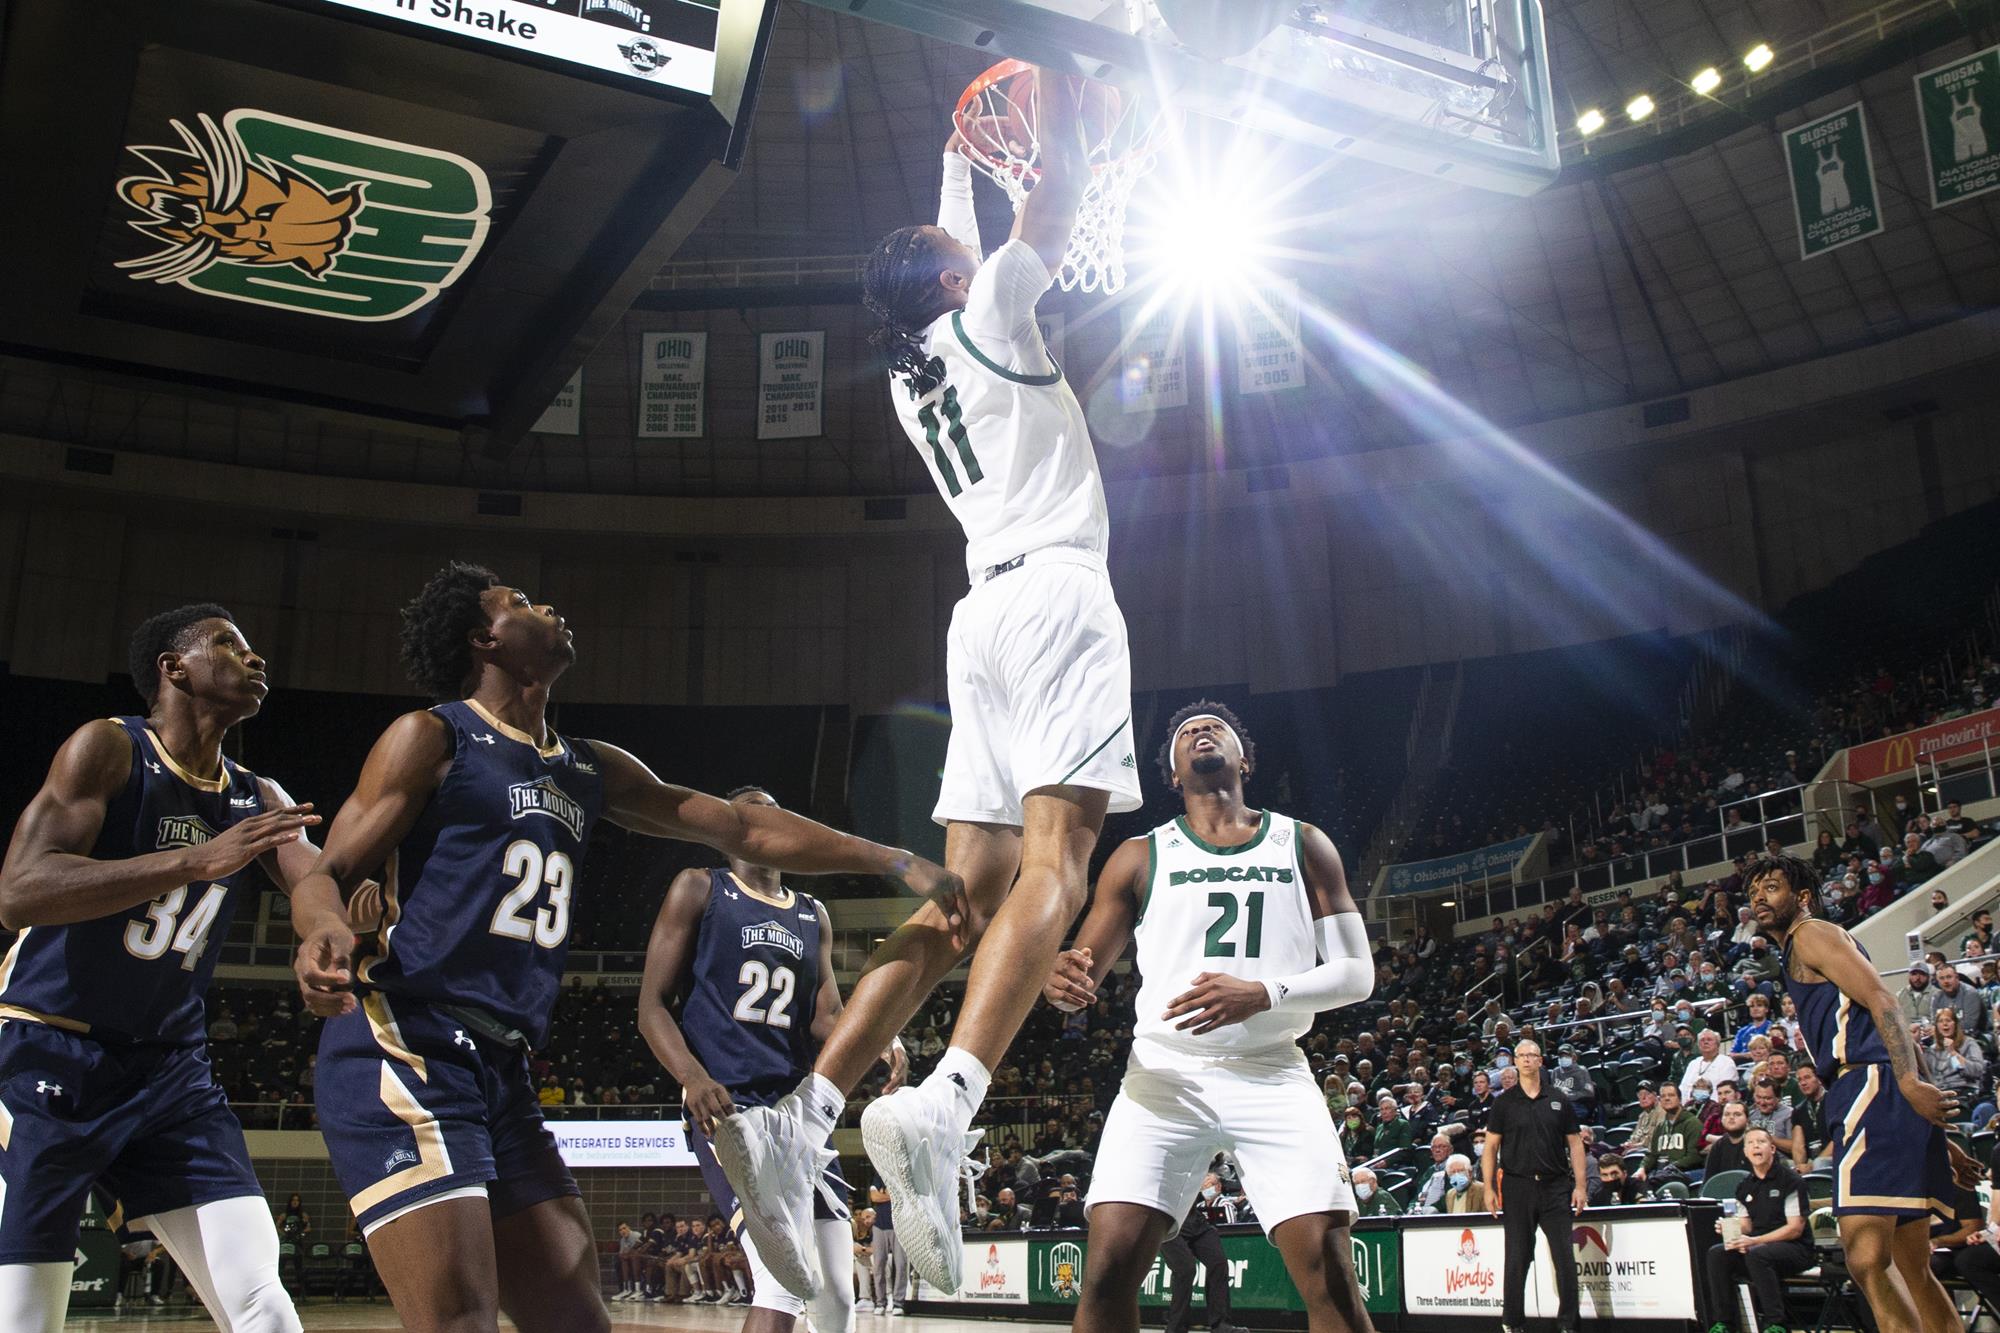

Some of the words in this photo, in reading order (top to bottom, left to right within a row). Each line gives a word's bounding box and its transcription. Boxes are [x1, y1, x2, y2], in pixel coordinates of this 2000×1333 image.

[430, 0, 538, 40] Shake
[1934, 60, 1984, 88] HOUSKA
[1799, 117, 1848, 145] BLOSSER
[1938, 162, 2000, 187] CHAMPIO
[1940, 153, 2000, 178] NATIONA
[1954, 172, 1998, 194] 1964
[1806, 210, 1872, 240] CHAMPION
[1807, 205, 1868, 231] NATIONAL
[1820, 224, 1861, 245] 1932
[656, 339, 692, 360] OHIO
[774, 339, 810, 360] OHIO
[1245, 354, 1279, 368] SWEET
[1284, 351, 1297, 364] 16
[644, 382, 701, 392] TOURNAMENT
[663, 373, 683, 382] MAC
[763, 381, 819, 392] TOURNAMENT
[781, 373, 801, 382] MAC
[1254, 370, 1290, 386] 2005
[647, 391, 698, 400] CHAMPIONS
[765, 391, 817, 400] CHAMPIONS
[917, 384, 984, 498] 11
[1920, 737, 1940, 751] i'm
[1942, 724, 1980, 747] lovin'
[1980, 721, 1992, 737] it
[230, 796, 256, 806] NEC
[512, 786, 540, 812] THE
[542, 791, 583, 833] MOUNT
[161, 819, 190, 842] THE
[1169, 866, 1293, 887] BOBCATS
[1413, 862, 1469, 883] OhioHealth
[1486, 851, 1525, 867] OhioHea
[489, 839, 574, 949] 23
[1587, 887, 1633, 905] RESERVD
[123, 884, 229, 972] 34
[1204, 891, 1265, 958] 21
[745, 928, 765, 943] THE
[767, 930, 802, 955] MOUNT
[733, 960, 796, 1030] 22
[558, 1137, 621, 1149] INTEGRATED
[625, 1136, 676, 1149] SERVICES
[1445, 1262, 1494, 1294] Wendy's
[1575, 1261, 1612, 1276] DAVID
[1616, 1260, 1656, 1276] WHITE
[980, 1270, 1006, 1290] Wendy's
[1416, 1295, 1433, 1307] Three
[1434, 1295, 1469, 1308] Convenient
[1470, 1296, 1491, 1308] Athens
